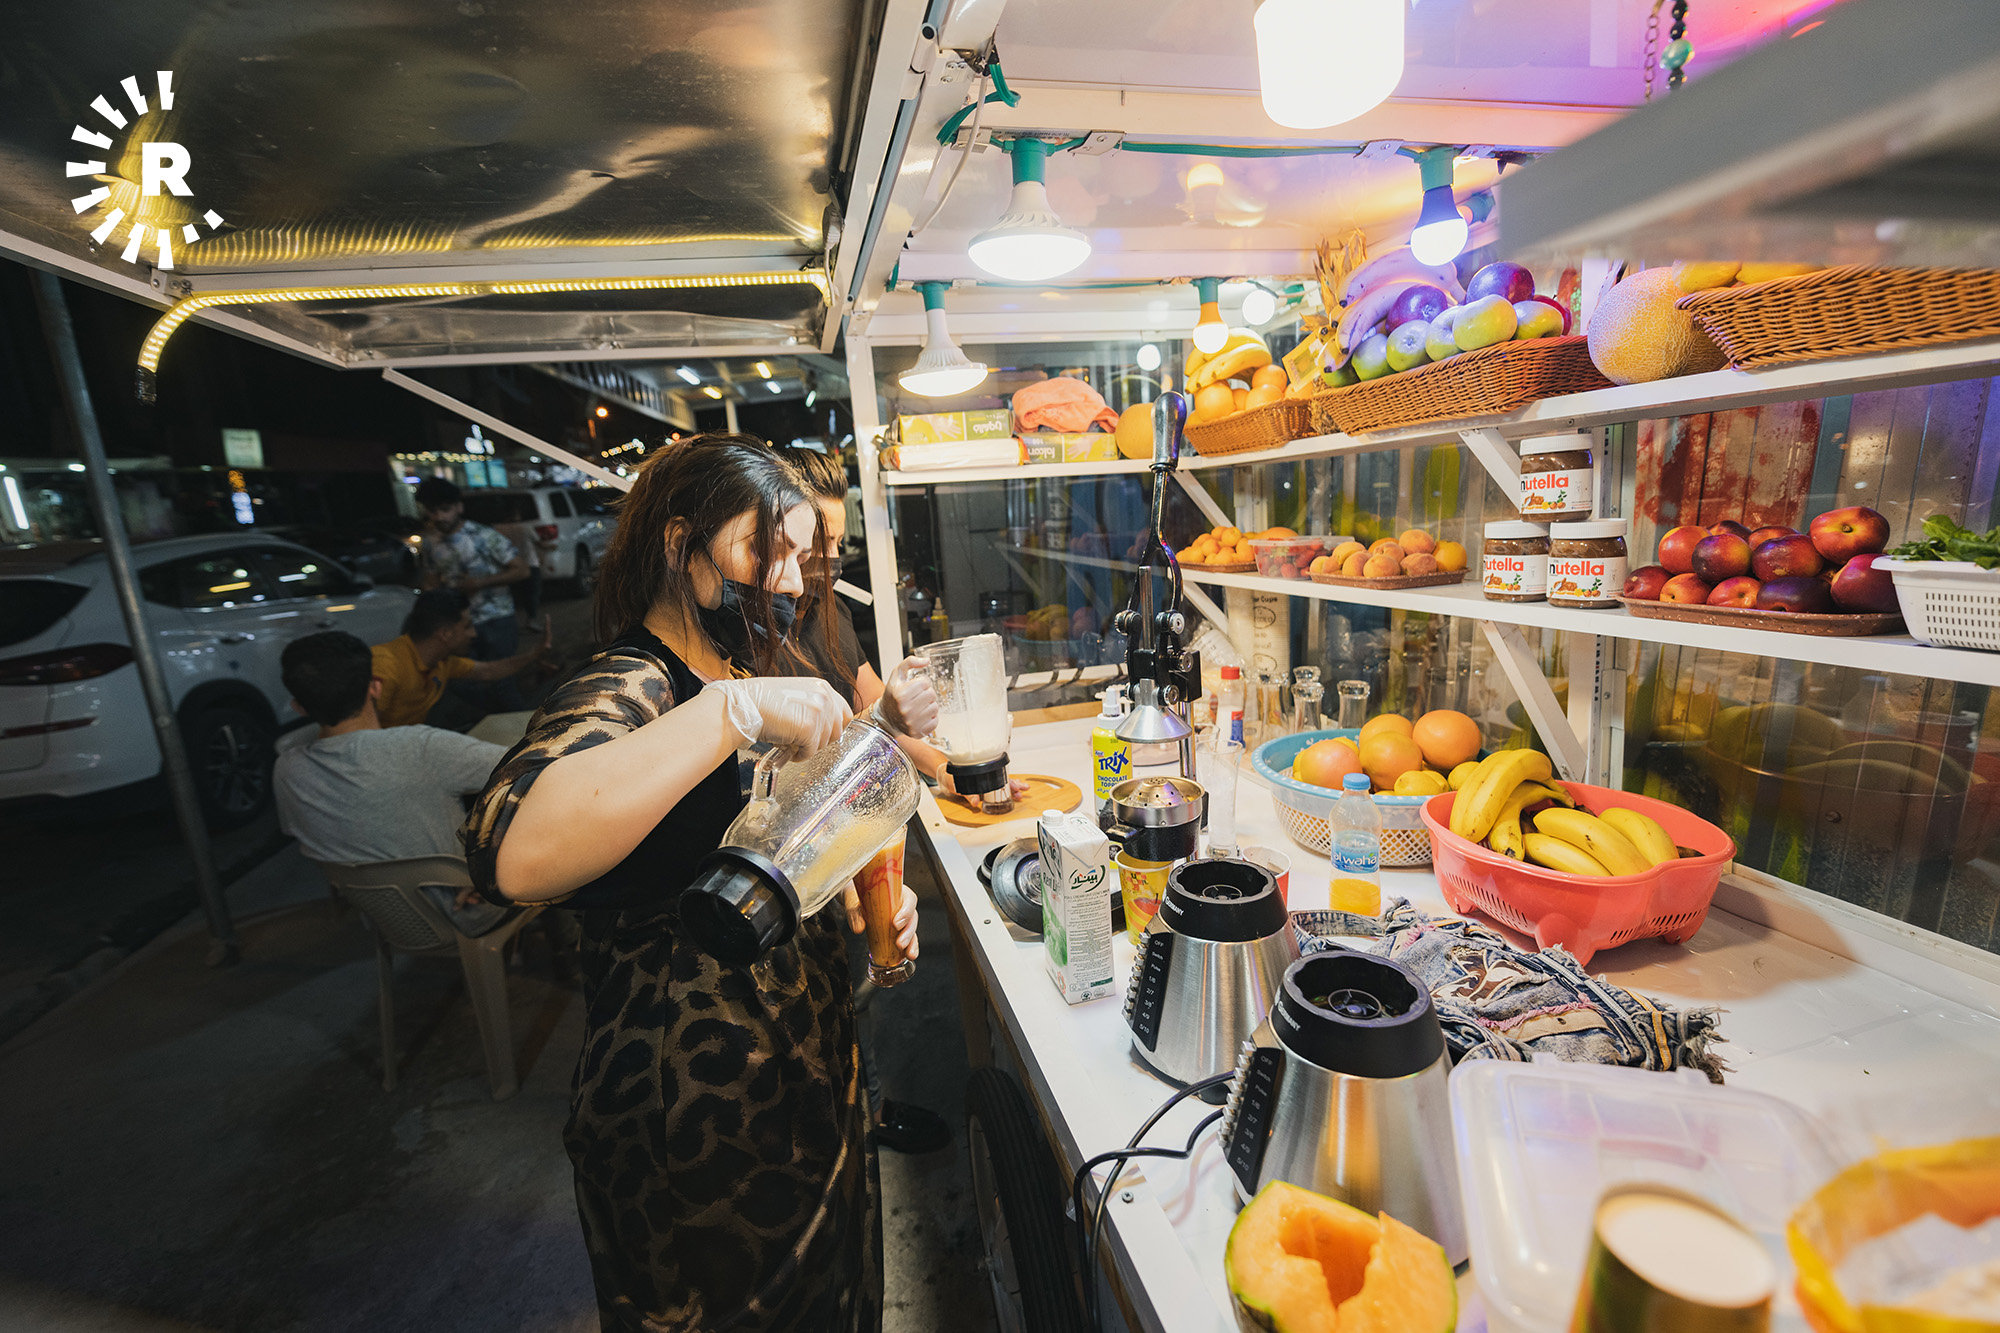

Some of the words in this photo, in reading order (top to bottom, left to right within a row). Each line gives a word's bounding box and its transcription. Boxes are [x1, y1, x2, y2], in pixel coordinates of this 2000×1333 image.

[1520, 473, 1569, 491] nutella
[1549, 560, 1605, 576] nutella
[1097, 774, 1128, 783] CHOCOLATE
